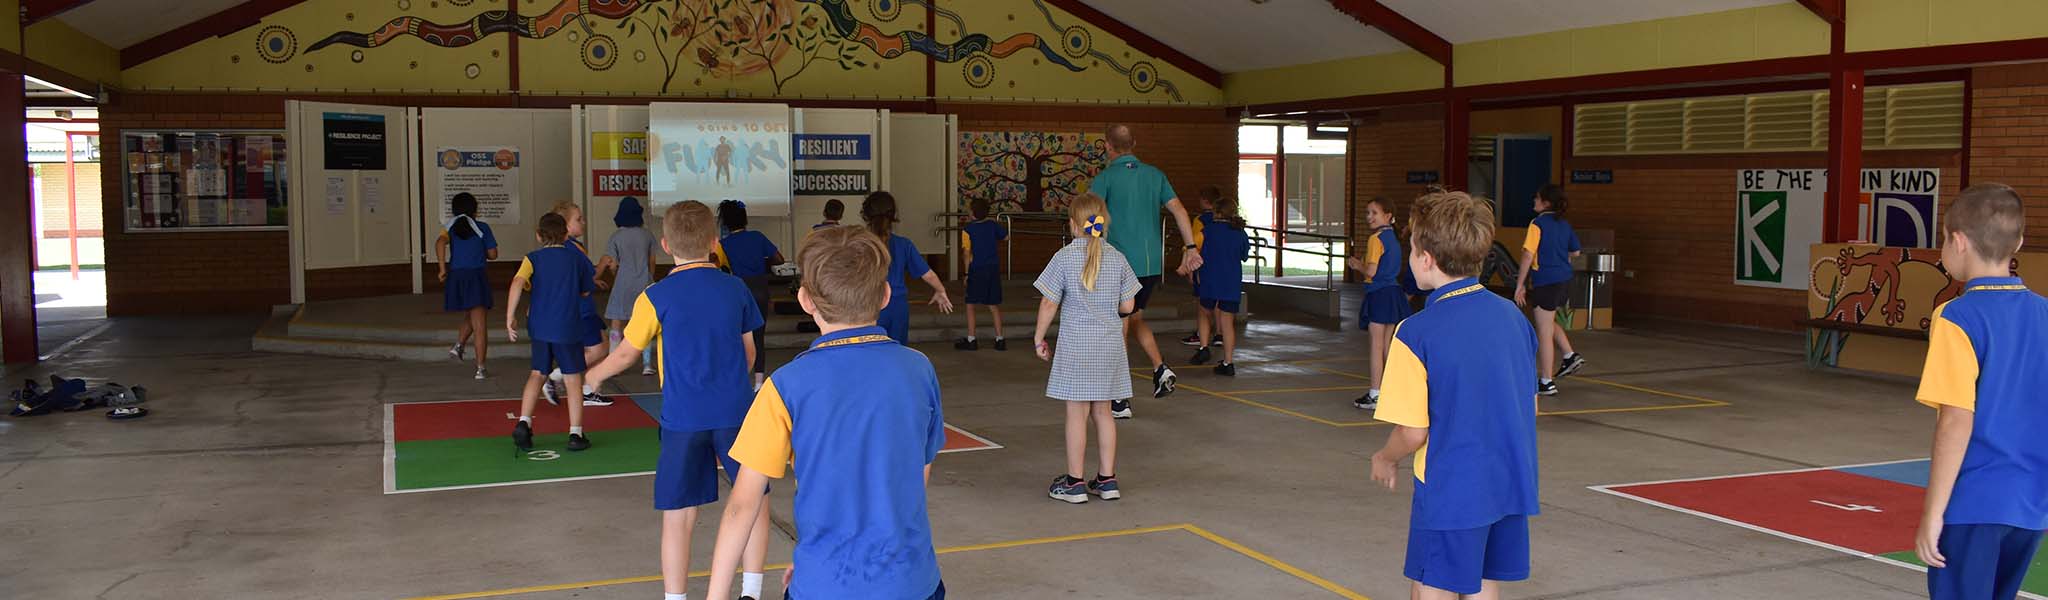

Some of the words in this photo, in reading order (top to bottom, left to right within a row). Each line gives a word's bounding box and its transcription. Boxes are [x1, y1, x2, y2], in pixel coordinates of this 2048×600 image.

[623, 138, 648, 155] SAF
[799, 139, 858, 156] RESILIENT
[662, 139, 786, 174] FUKY
[599, 175, 648, 192] RESPEC
[792, 175, 867, 191] SUCCESSFUL
[1743, 171, 1764, 190] BE
[1776, 170, 1812, 190] THE
[1862, 171, 1882, 191] IN
[1890, 172, 1936, 194] KIND
